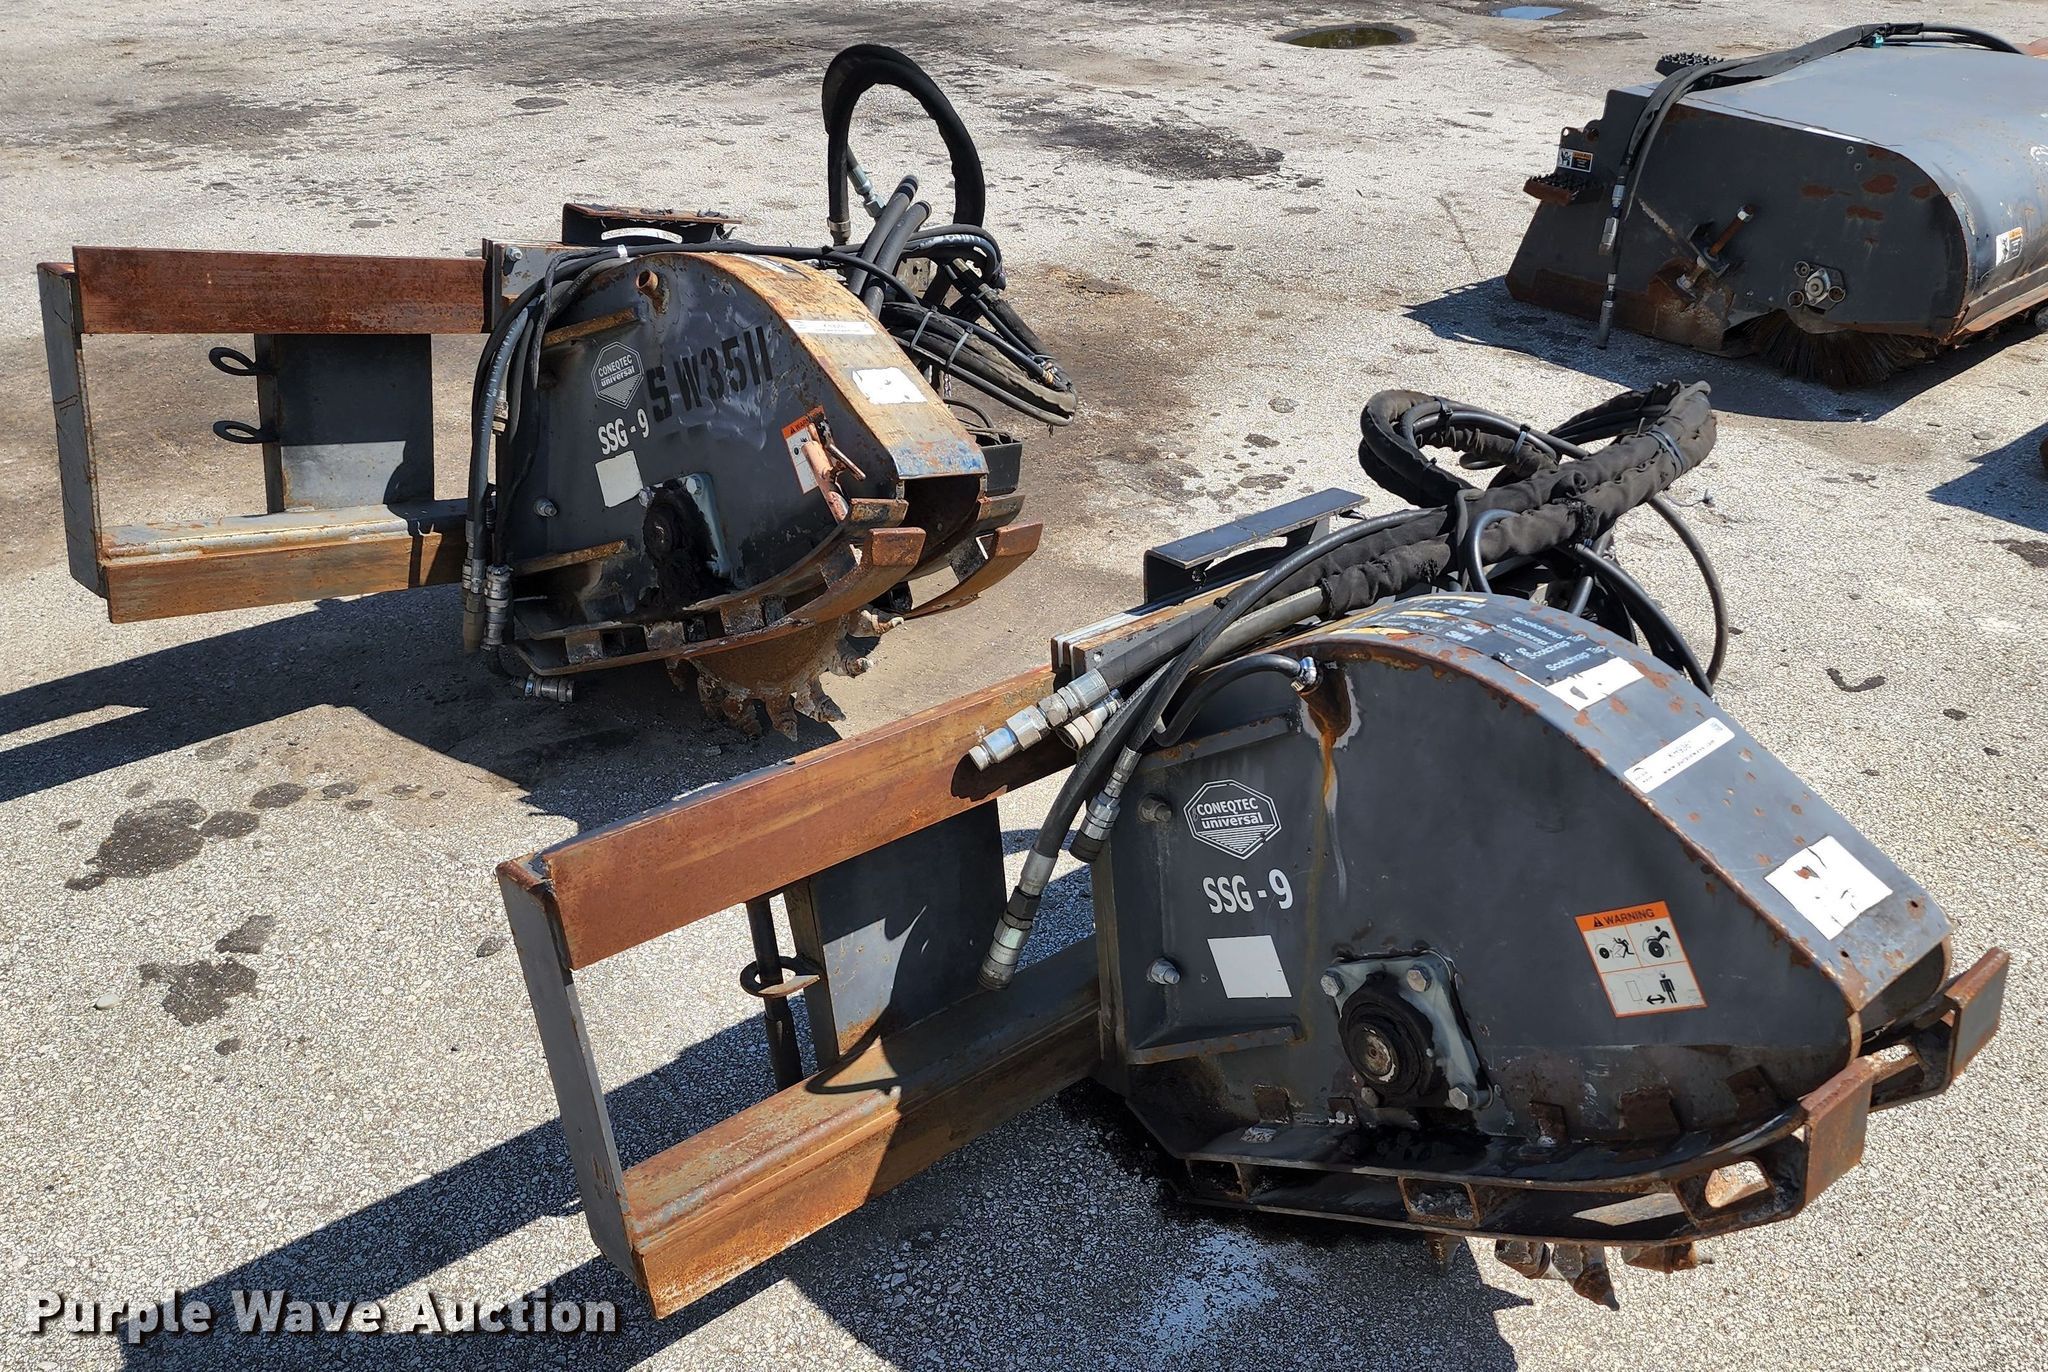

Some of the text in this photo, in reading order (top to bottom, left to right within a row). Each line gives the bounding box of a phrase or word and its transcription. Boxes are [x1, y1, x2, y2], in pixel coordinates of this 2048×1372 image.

[598, 354, 633, 377] CONEQTEC
[601, 365, 635, 387] universal
[1196, 797, 1259, 815] CONEQTEC
[1201, 812, 1264, 829] universal
[1603, 908, 1655, 925] WARNING
